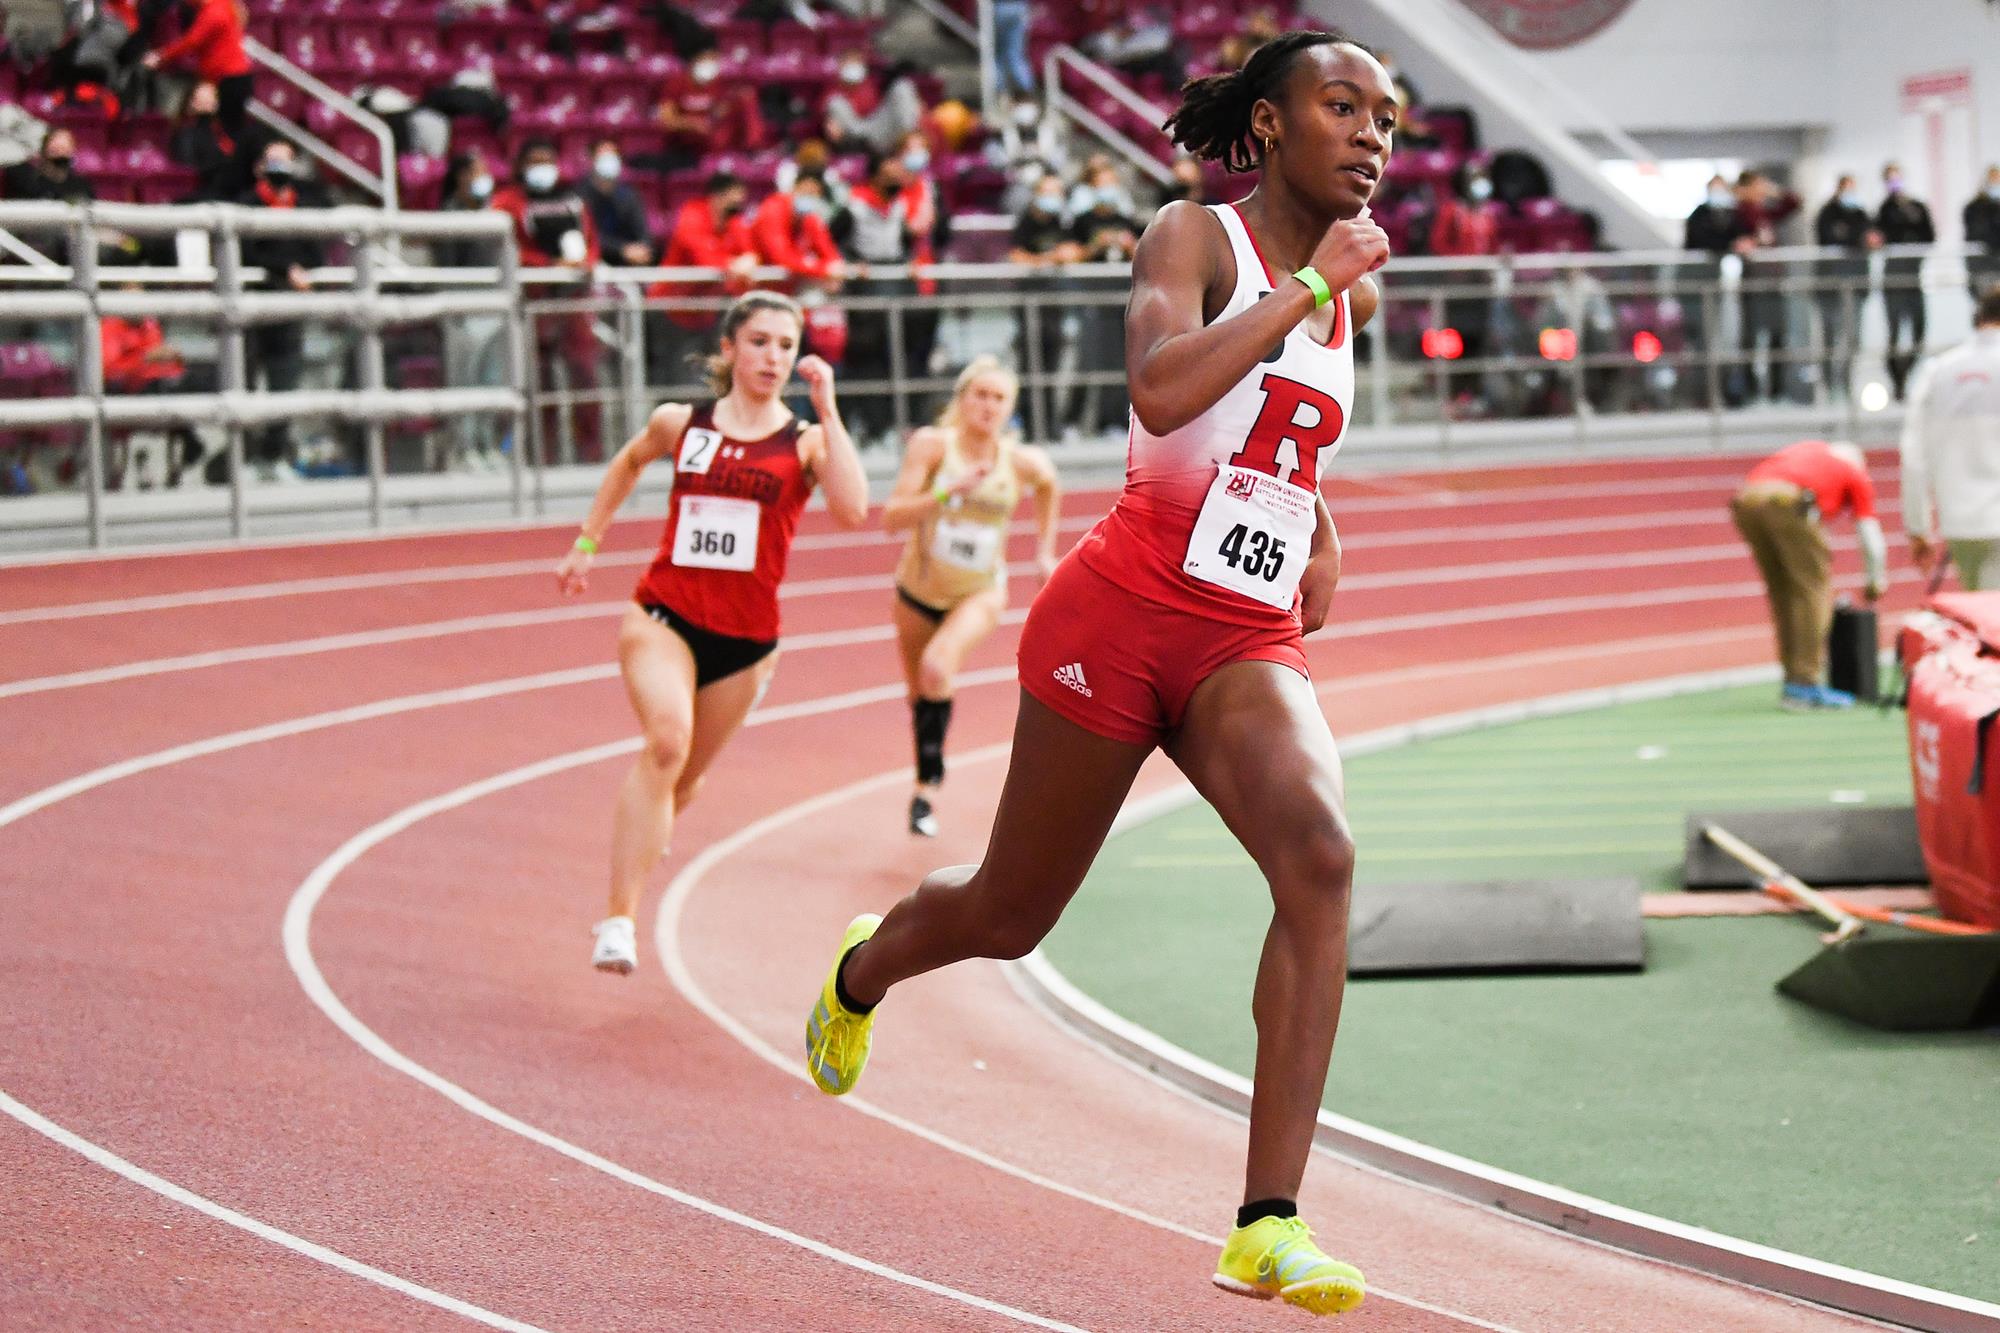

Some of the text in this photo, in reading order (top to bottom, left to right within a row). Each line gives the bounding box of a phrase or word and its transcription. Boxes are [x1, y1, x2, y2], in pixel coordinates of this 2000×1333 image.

[1229, 373, 1344, 493] R
[685, 434, 711, 467] 2
[1226, 470, 1259, 497] BU
[1259, 478, 1282, 492] BOSTON
[690, 529, 736, 556] 360
[1218, 523, 1287, 583] 435
[1053, 670, 1093, 698] adidas
